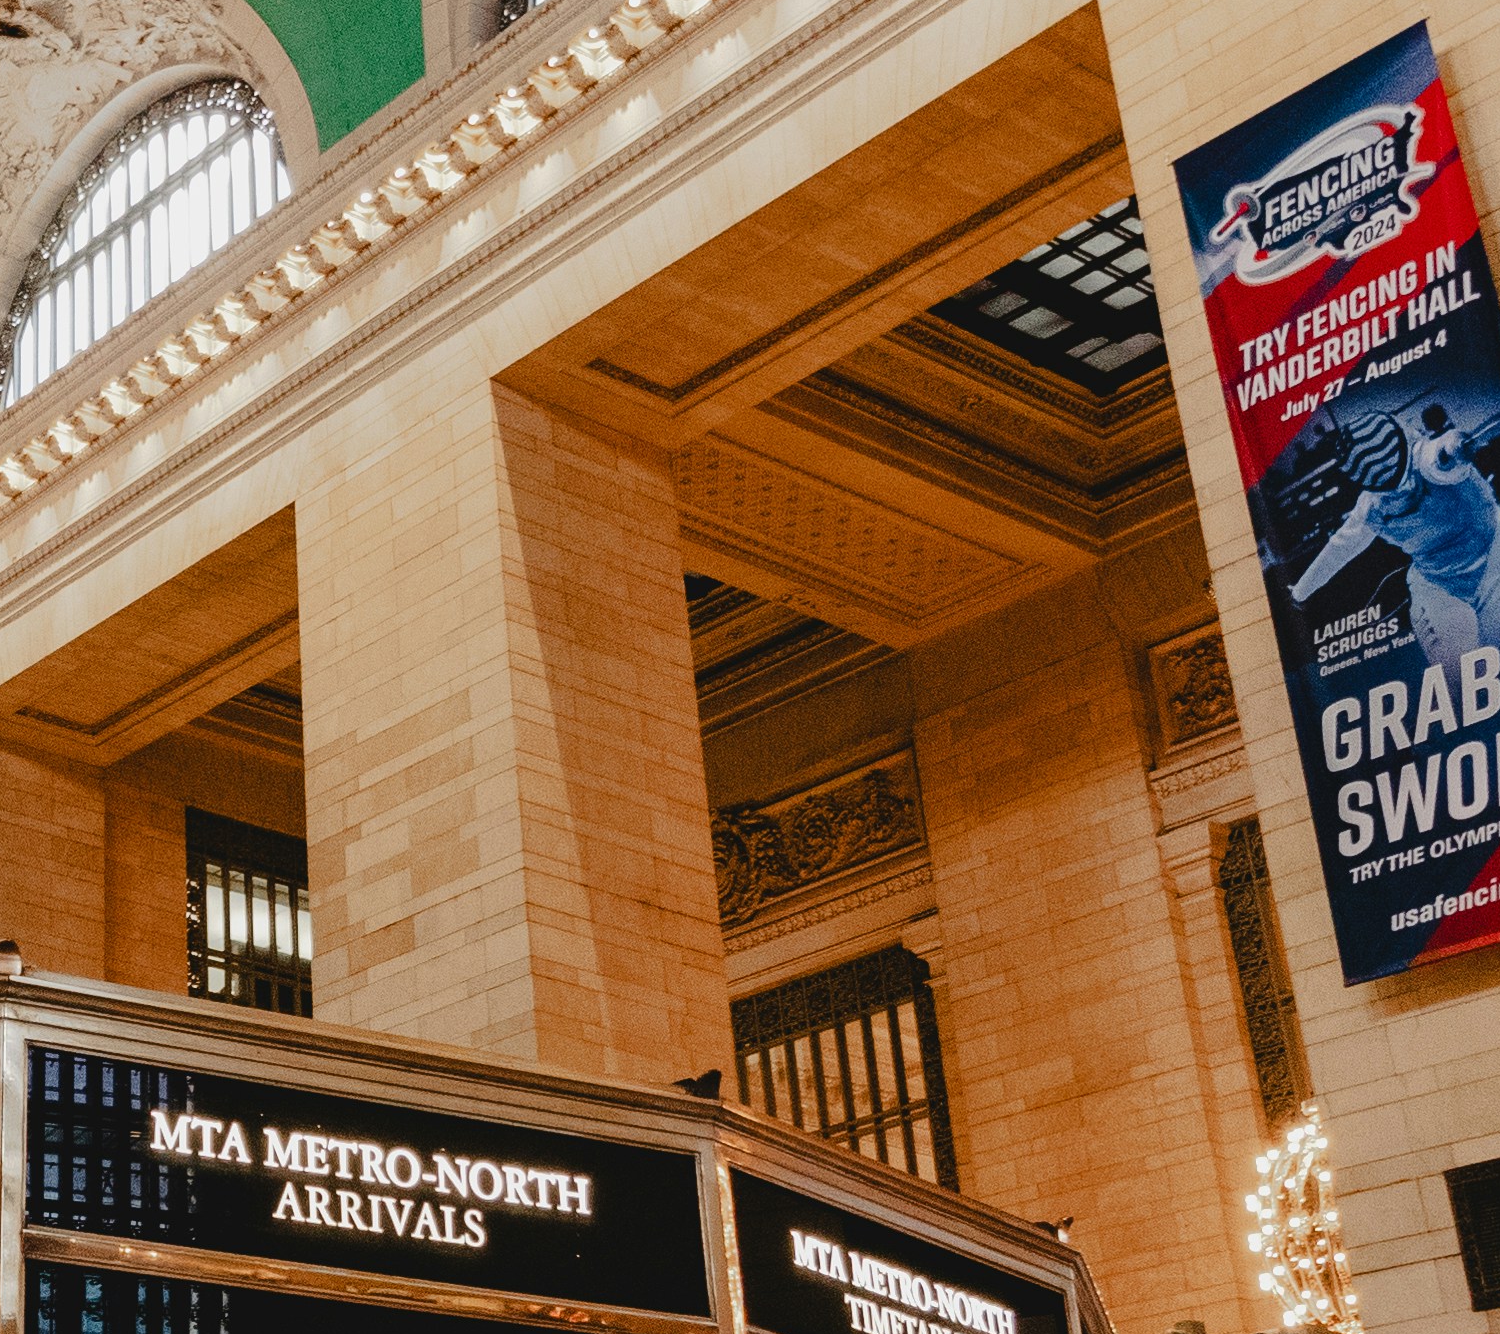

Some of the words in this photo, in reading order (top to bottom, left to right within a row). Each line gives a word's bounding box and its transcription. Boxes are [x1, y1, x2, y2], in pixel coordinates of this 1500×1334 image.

[1261, 204, 1323, 249] ACROSS
[1325, 164, 1398, 216] AMERICA
[1352, 216, 1397, 251] 2024
[1239, 322, 1291, 373] TRY
[1296, 260, 1418, 347] FENCING
[1425, 240, 1457, 284] IN
[1236, 305, 1401, 412] VANDERBILT
[1407, 270, 1481, 331] HALL
[1280, 390, 1319, 422] July
[1323, 377, 1345, 402] 27
[1364, 338, 1431, 384] August
[1434, 329, 1448, 348] 4
[1313, 603, 1381, 645] LAUREN
[1317, 617, 1399, 663] SCRUGGS
[1363, 644, 1390, 660] New
[1391, 632, 1416, 649] York
[1349, 860, 1383, 884] TRY
[1387, 847, 1426, 873] THE
[150, 1110, 251, 1164] MTA
[263, 1127, 593, 1215] METRO-NORTH
[272, 1181, 488, 1248] ARRIVALS
[789, 1229, 851, 1284] MTA
